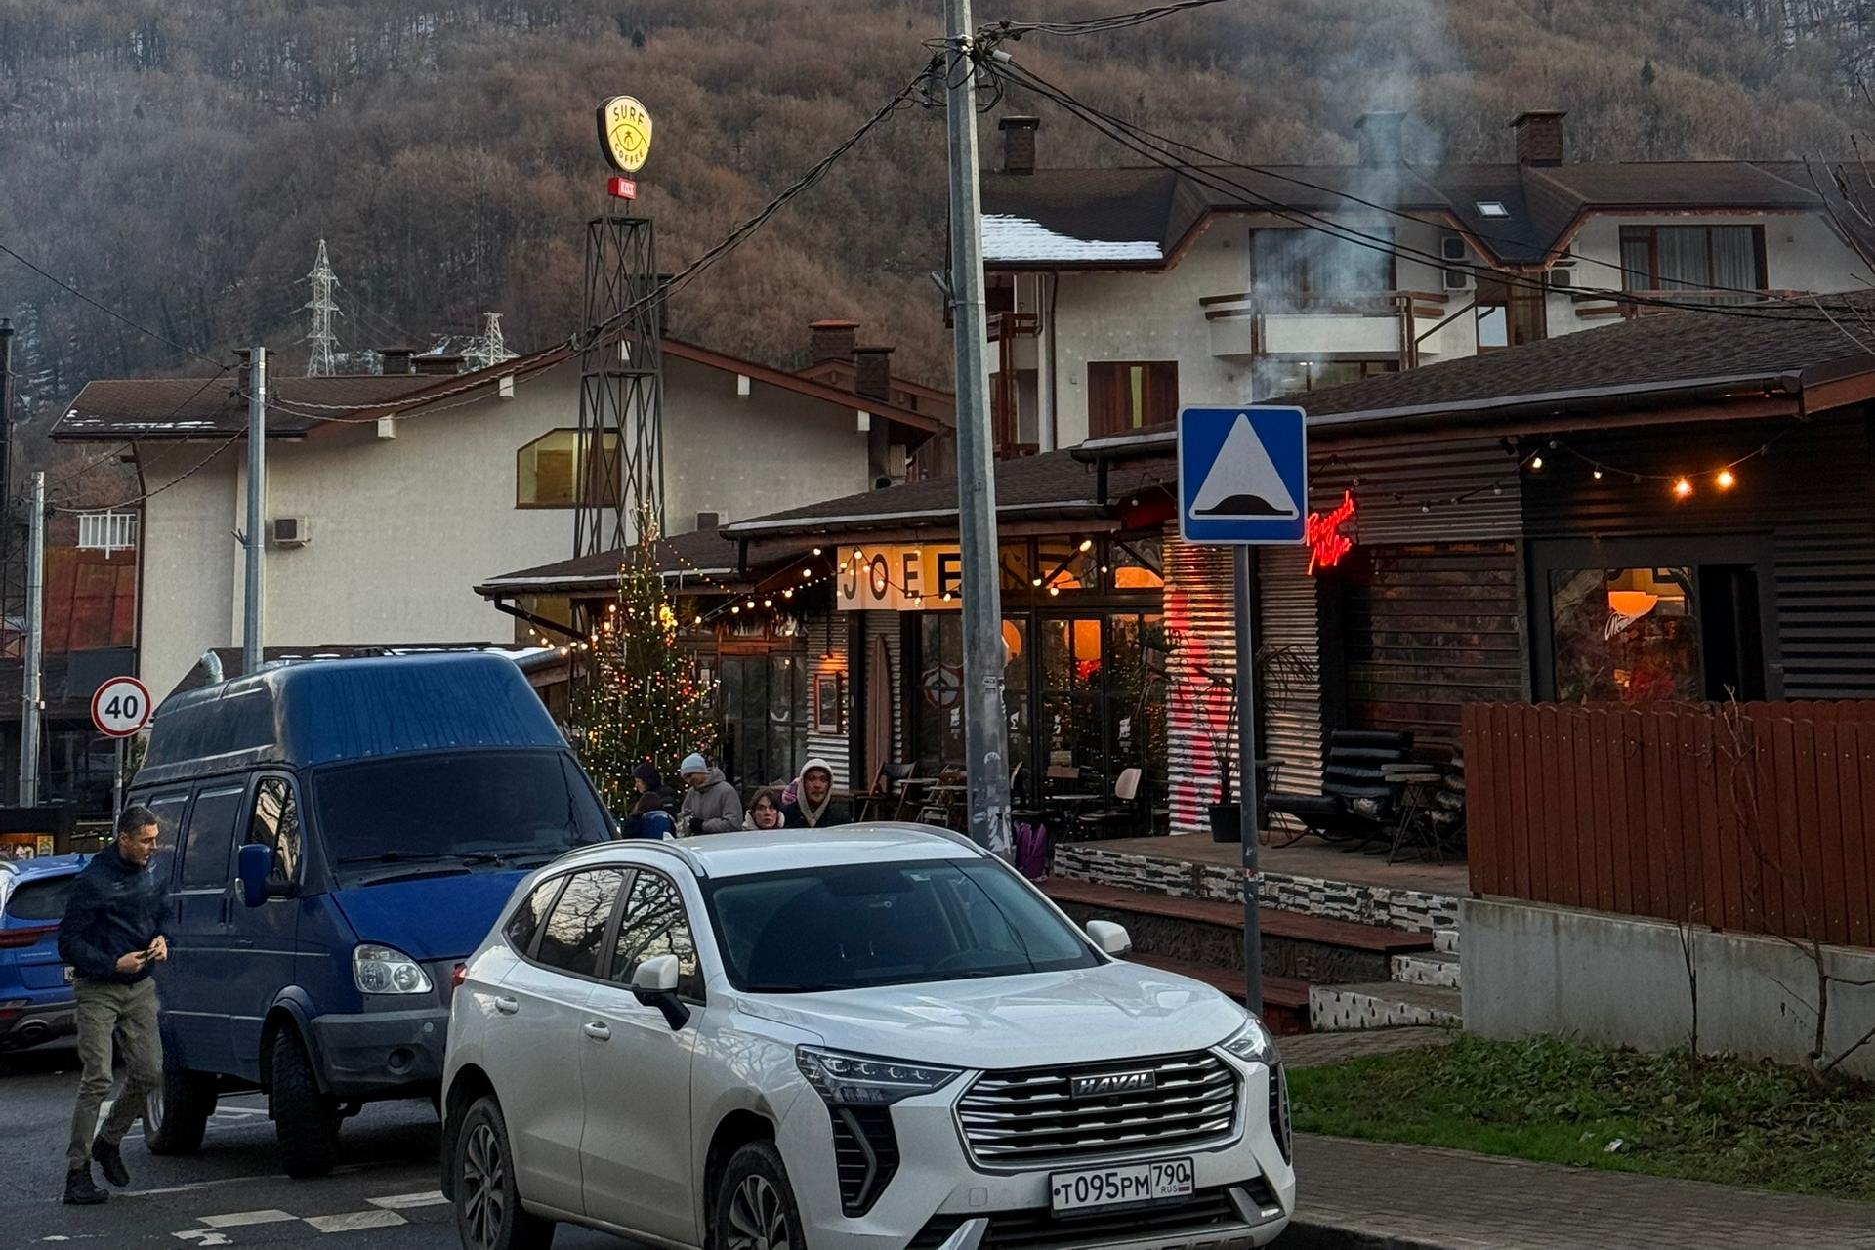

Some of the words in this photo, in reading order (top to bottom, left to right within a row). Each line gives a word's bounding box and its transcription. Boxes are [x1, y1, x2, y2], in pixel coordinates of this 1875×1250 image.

[613, 104, 645, 125] SURF
[615, 143, 644, 164] COFFEE
[105, 695, 138, 719] 40
[1079, 1073, 1152, 1093] HAVAL
[1152, 1163, 1187, 1187] 790
[1160, 1186, 1178, 1194] RUS
